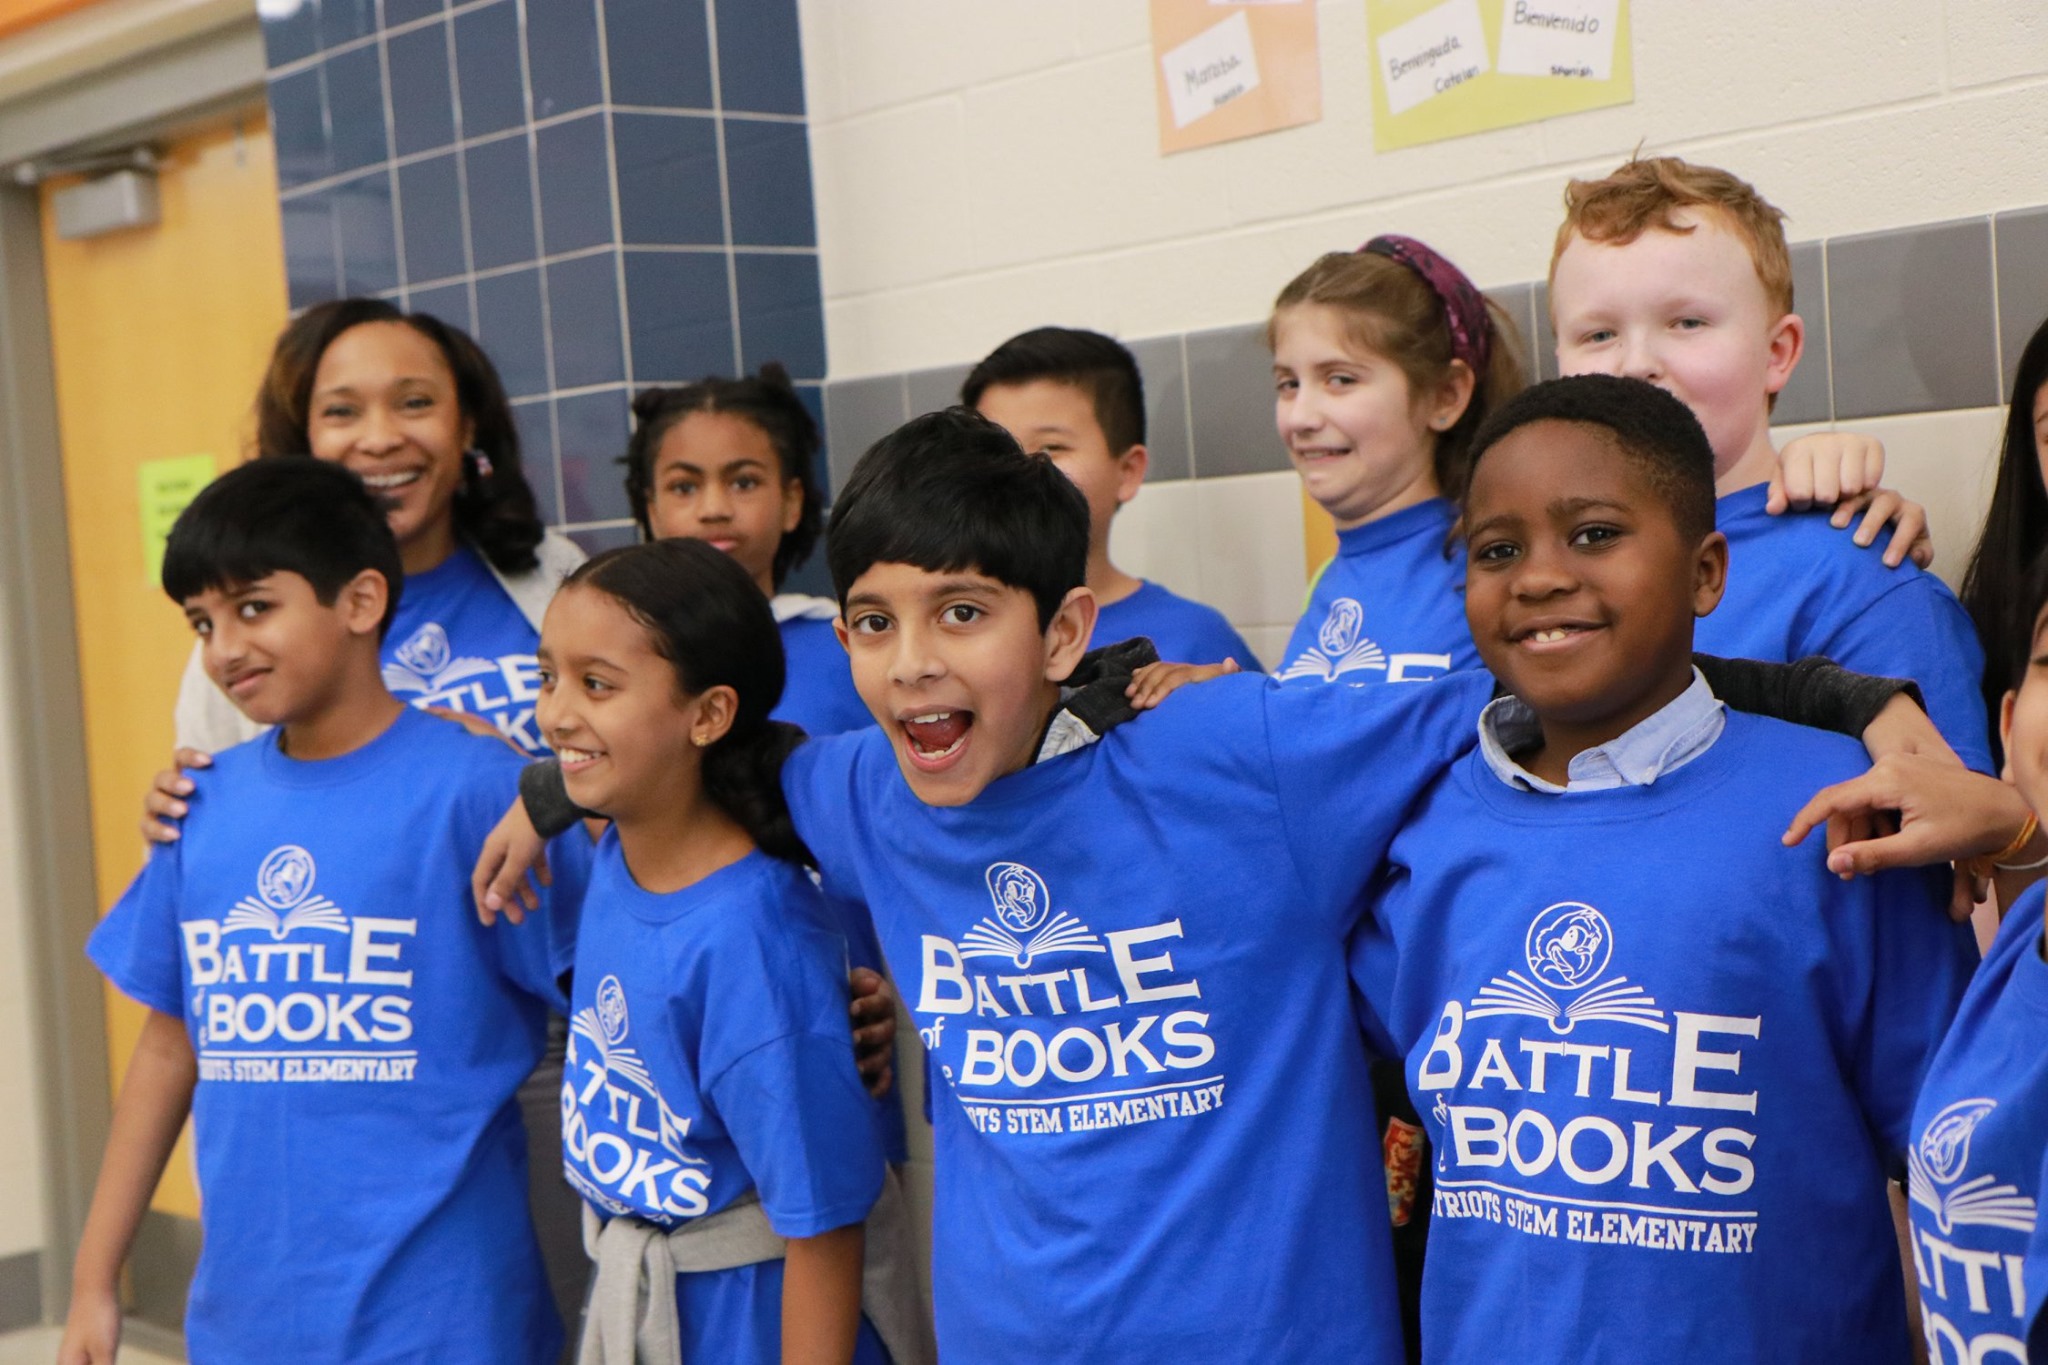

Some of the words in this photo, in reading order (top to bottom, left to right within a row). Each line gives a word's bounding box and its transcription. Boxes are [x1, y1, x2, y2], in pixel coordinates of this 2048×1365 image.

[1514, 0, 1599, 34] Bienvenido
[181, 916, 417, 988] BATTLE
[915, 918, 1201, 1018] BATTLE
[208, 992, 413, 1042] BOOKS
[959, 1011, 1215, 1087] BOOKS
[235, 1058, 279, 1081] STEM
[284, 1057, 417, 1082] ELEMENTARY
[1418, 1001, 1761, 1115] BATTLE
[1006, 1106, 1063, 1134] STEM
[1068, 1084, 1225, 1131] ELEMENTARY
[1448, 1106, 1756, 1195] BOOKS
[1432, 1188, 1501, 1223] TRIOTS
[1506, 1198, 1558, 1237] STEM
[1566, 1210, 1757, 1253] ELEMENTARY
